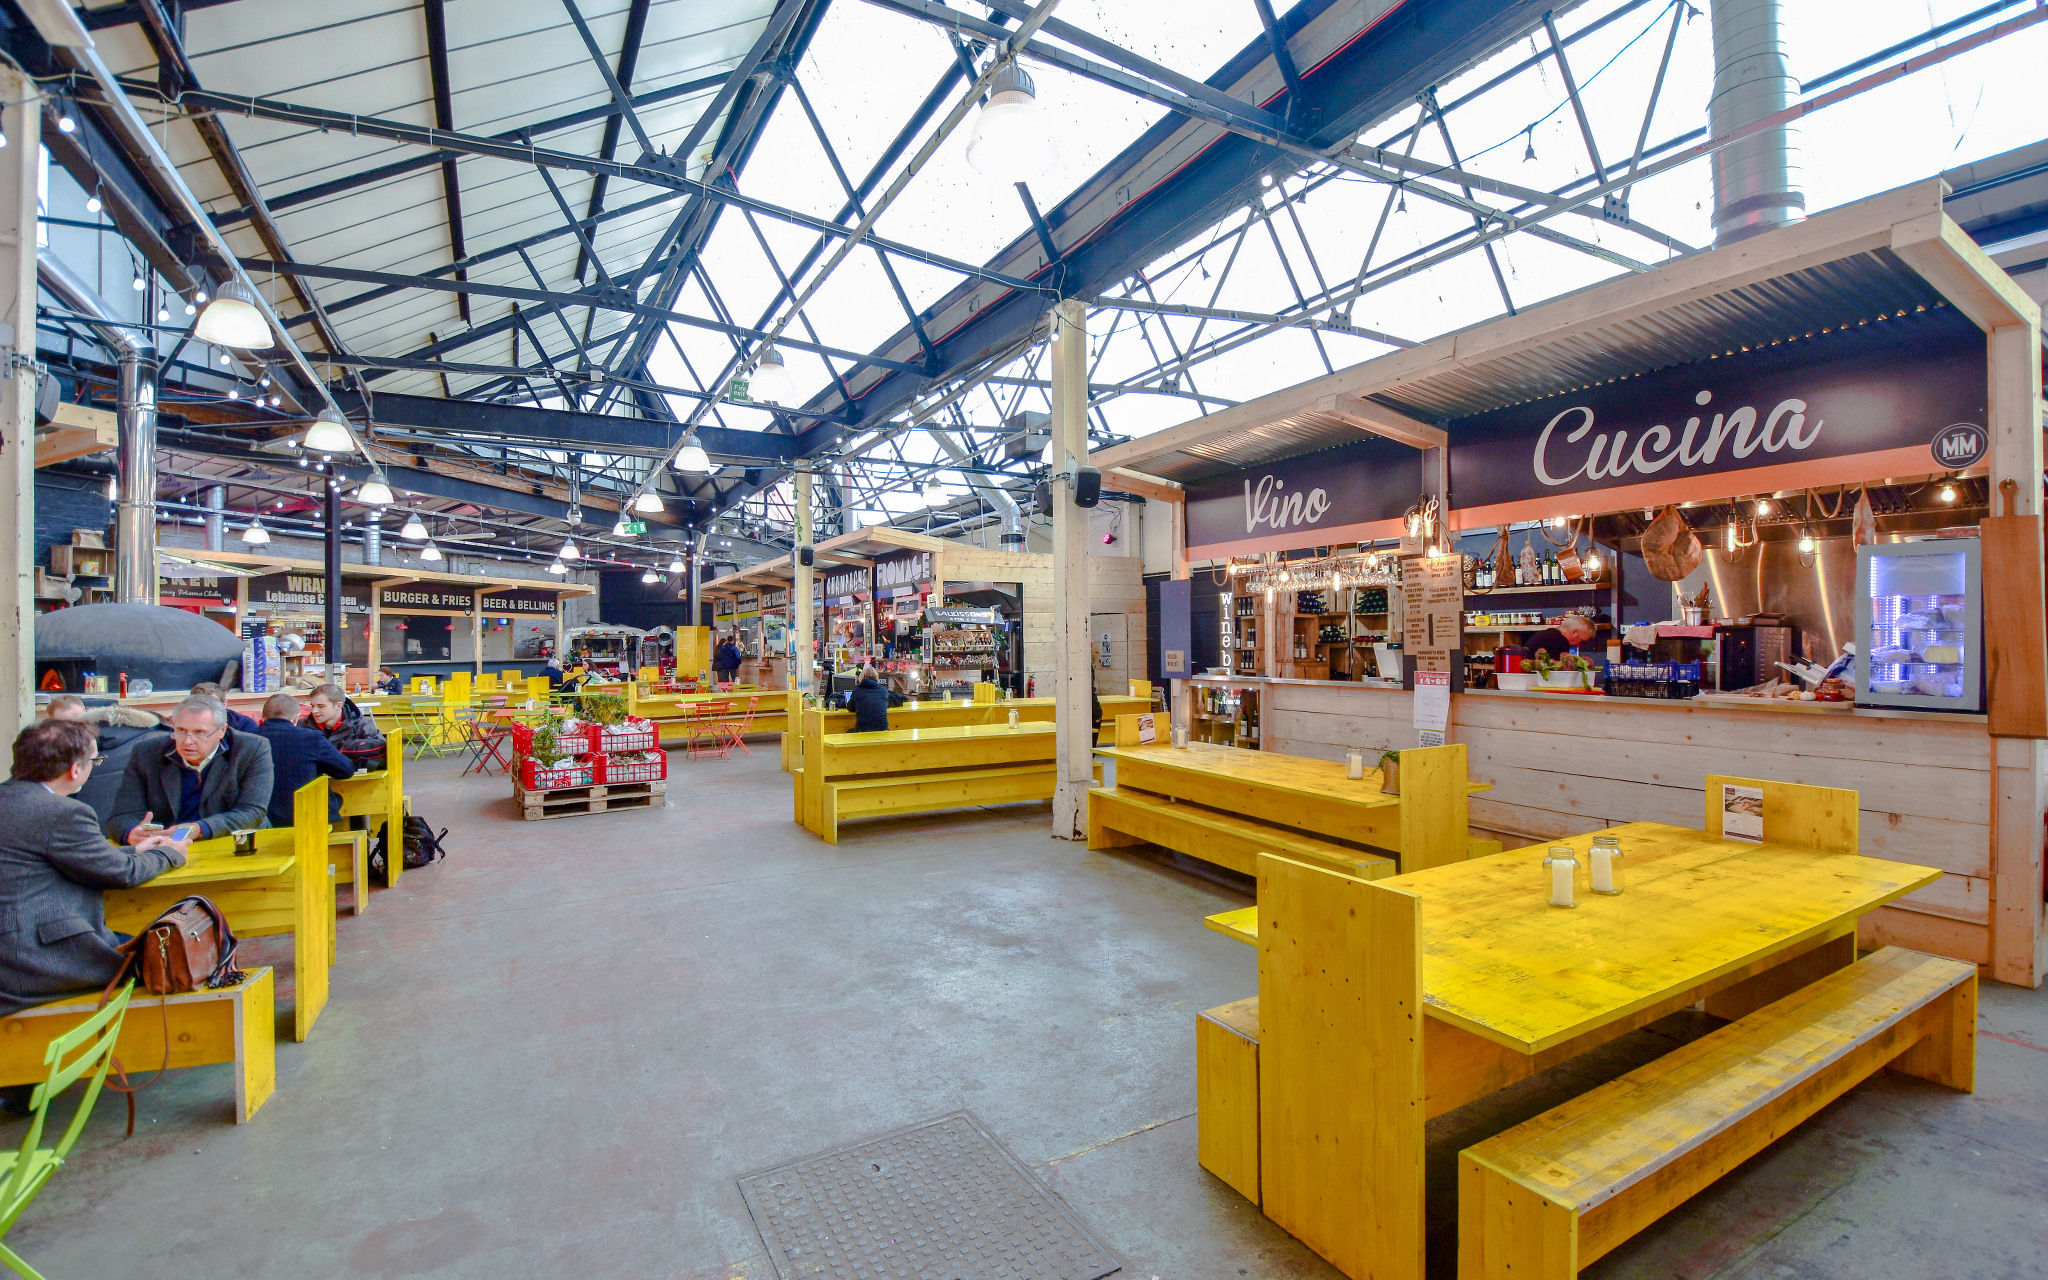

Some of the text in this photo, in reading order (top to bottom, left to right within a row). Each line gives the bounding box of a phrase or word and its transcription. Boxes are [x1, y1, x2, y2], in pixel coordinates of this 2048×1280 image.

[1533, 390, 1824, 486] Cucina
[1942, 434, 1977, 458] MM
[1244, 474, 1332, 534] Vino
[876, 553, 931, 586] FROMAGE
[287, 576, 325, 594] WRA
[266, 590, 316, 604] Lebanese
[383, 591, 472, 607] BURGER & FRIES
[483, 597, 556, 612] BEER & BELLINIS
